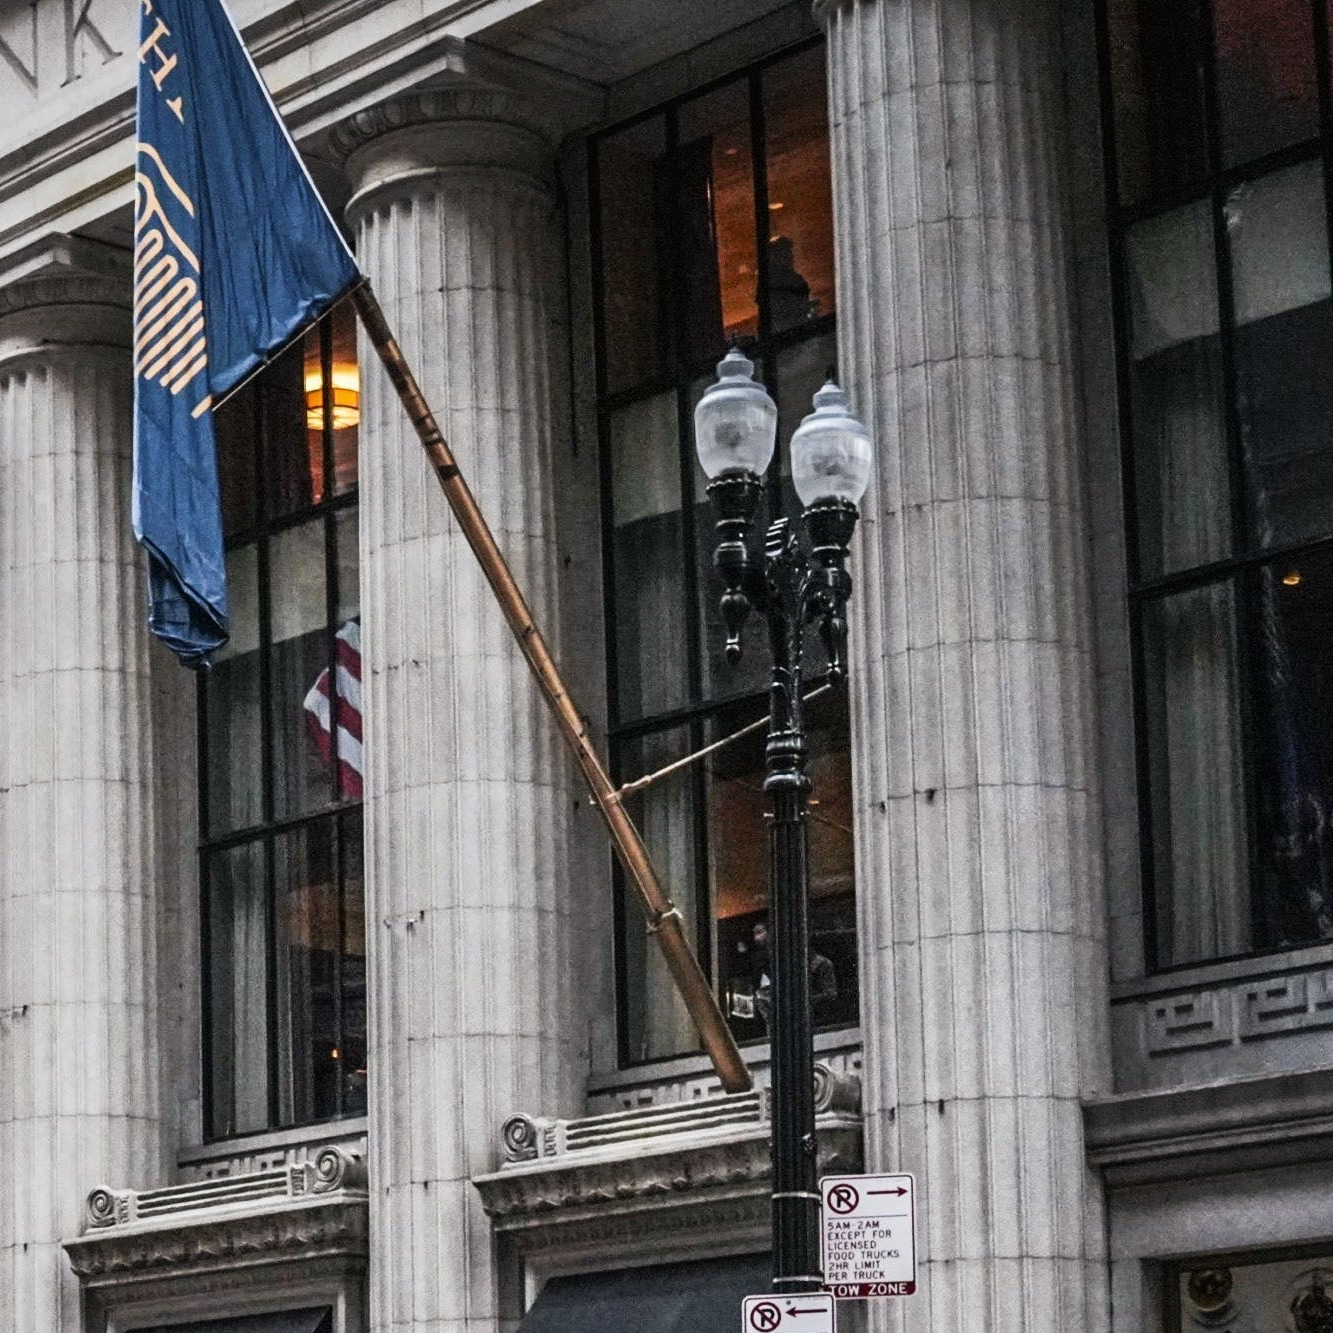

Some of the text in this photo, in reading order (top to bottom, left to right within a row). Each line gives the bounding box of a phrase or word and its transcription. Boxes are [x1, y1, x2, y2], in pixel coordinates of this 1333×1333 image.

[827, 1229, 892, 1241] EXCEPT FOR
[827, 1240, 877, 1251] LICENSED
[828, 1249, 900, 1261] FOOD TRUCKS
[828, 1260, 880, 1271] 2HR LIMIT
[828, 1270, 885, 1281] PER TRUCK
[828, 1283, 908, 1297] TOW ZONE
